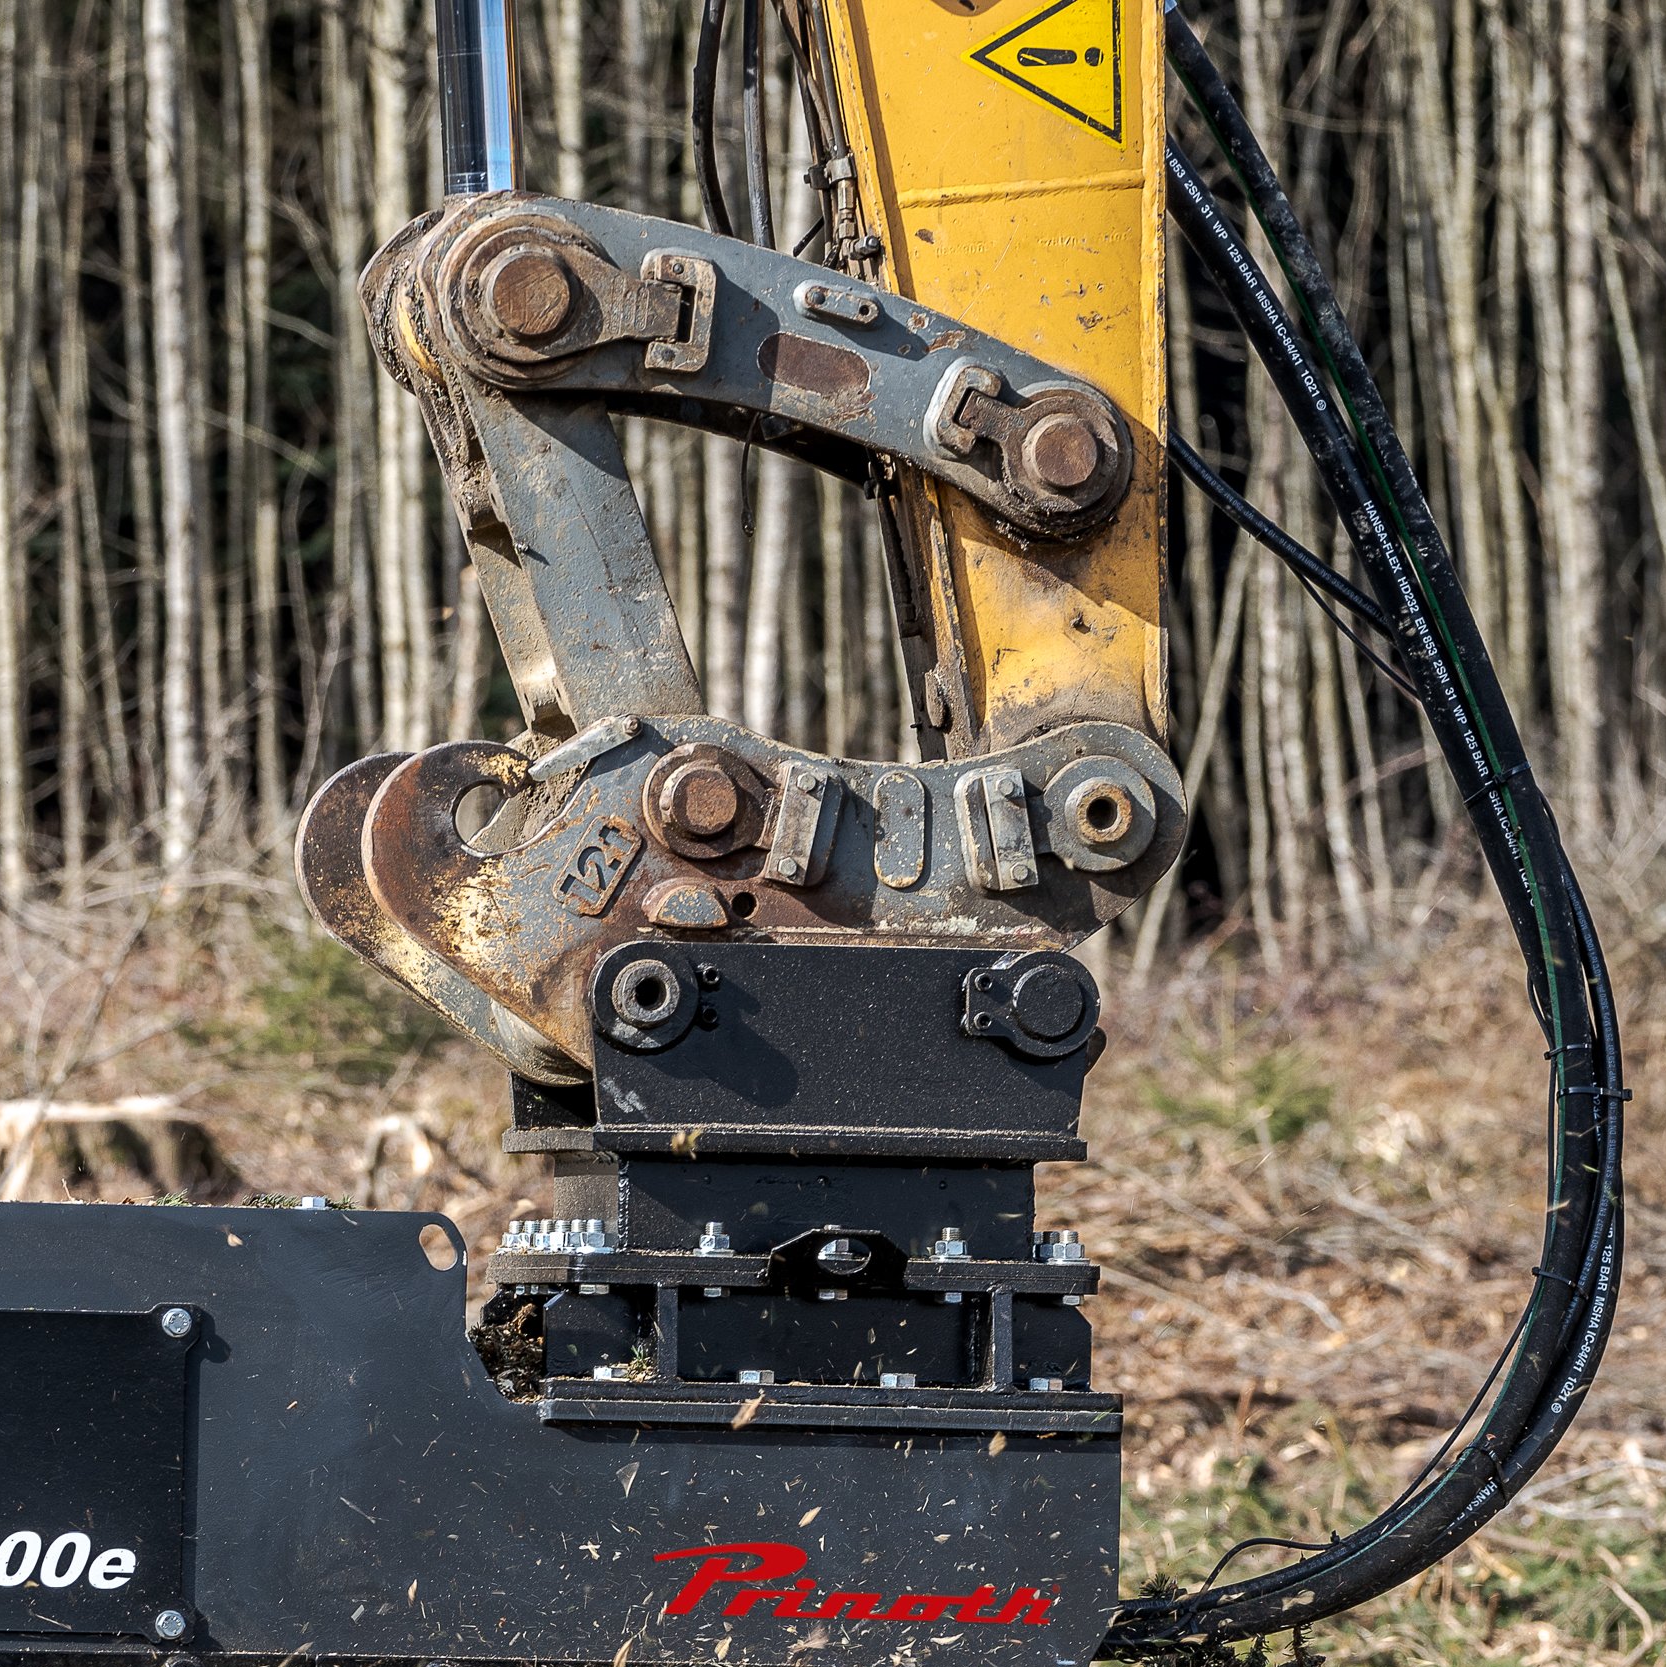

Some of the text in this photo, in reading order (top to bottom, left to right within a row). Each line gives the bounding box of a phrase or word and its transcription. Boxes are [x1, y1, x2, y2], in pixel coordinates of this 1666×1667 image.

[1167, 156, 1187, 179] 853
[1182, 178, 1204, 204] 2SN
[1199, 203, 1215, 219] 31
[1209, 219, 1229, 242] WP
[1224, 241, 1244, 264] 125
[1237, 261, 1259, 288] BAR
[1253, 288, 1281, 325] MSHA
[1273, 321, 1304, 366] IC-84/41
[1298, 367, 1321, 398] 1Q21
[1361, 498, 1403, 575] HANSA-FLEX
[1395, 575, 1421, 615] HD232
[1413, 615, 1430, 635] EN
[1421, 633, 1439, 657] 853
[1431, 657, 1451, 684] 2SN
[1443, 684, 1458, 701] 31
[1451, 703, 1469, 726] WP
[1462, 727, 1479, 751] 125
[1471, 748, 1490, 778] BAR
[1600, 1243, 1613, 1264] 125
[1596, 1264, 1611, 1292] BAR
[1587, 1294, 1606, 1330] MSHA
[1571, 1329, 1597, 1373] IC-84/41
[1556, 1374, 1579, 1403] 1Q21
[653, 1542, 1054, 1625] Prinoth
